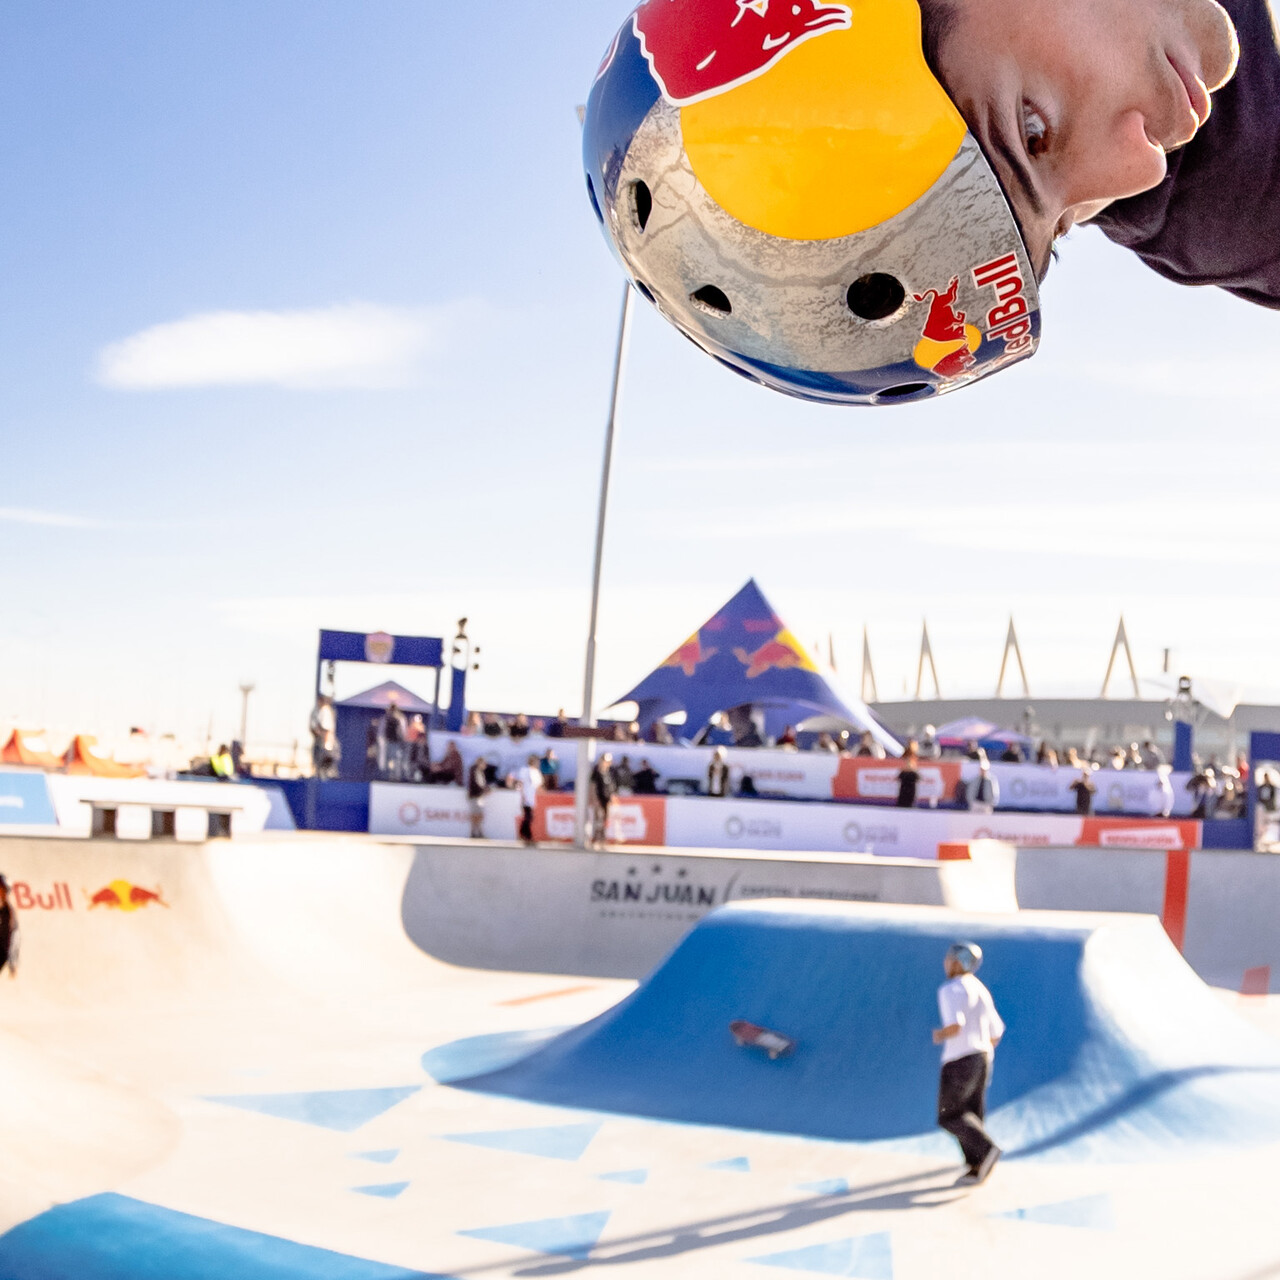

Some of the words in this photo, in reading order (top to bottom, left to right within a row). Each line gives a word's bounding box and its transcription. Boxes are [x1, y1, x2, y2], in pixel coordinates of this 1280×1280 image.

[12, 880, 74, 911] Bull
[590, 879, 642, 903] SAN
[645, 882, 717, 907] JUAN
